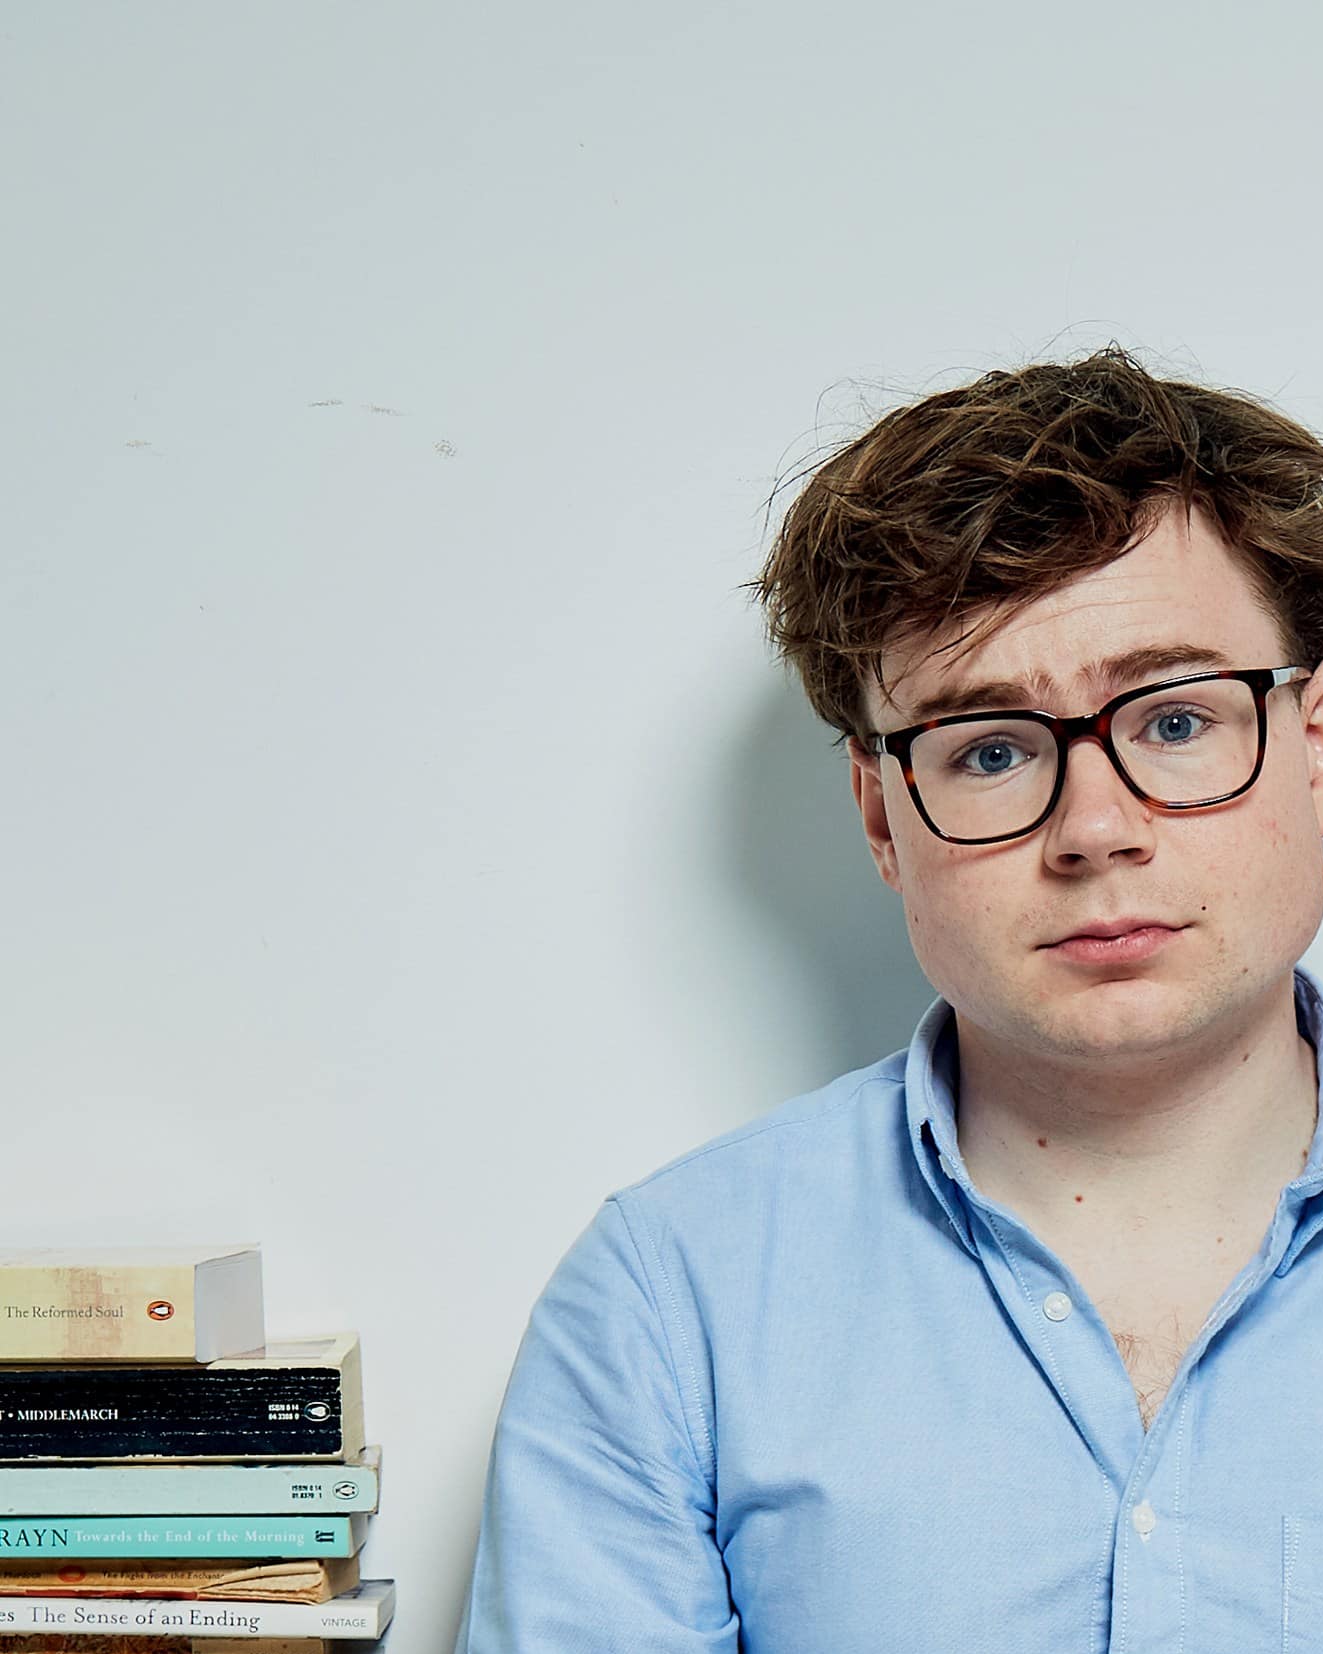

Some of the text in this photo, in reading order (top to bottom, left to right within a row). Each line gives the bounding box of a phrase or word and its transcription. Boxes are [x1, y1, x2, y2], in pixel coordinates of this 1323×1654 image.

[5, 1304, 124, 1319] The Reformed Soul
[17, 1408, 119, 1421] MIDDLEMARCH
[74, 1529, 133, 1542] Towards
[137, 1529, 160, 1542] the
[165, 1530, 192, 1542] End
[197, 1529, 212, 1542] of
[216, 1529, 239, 1542] the
[244, 1529, 305, 1546] Morning
[31, 1606, 67, 1623] The
[73, 1606, 129, 1625] Sense
[135, 1608, 157, 1625] of
[161, 1613, 184, 1625] an
[190, 1609, 261, 1633] Ending
[321, 1618, 367, 1628] VINTAGE
